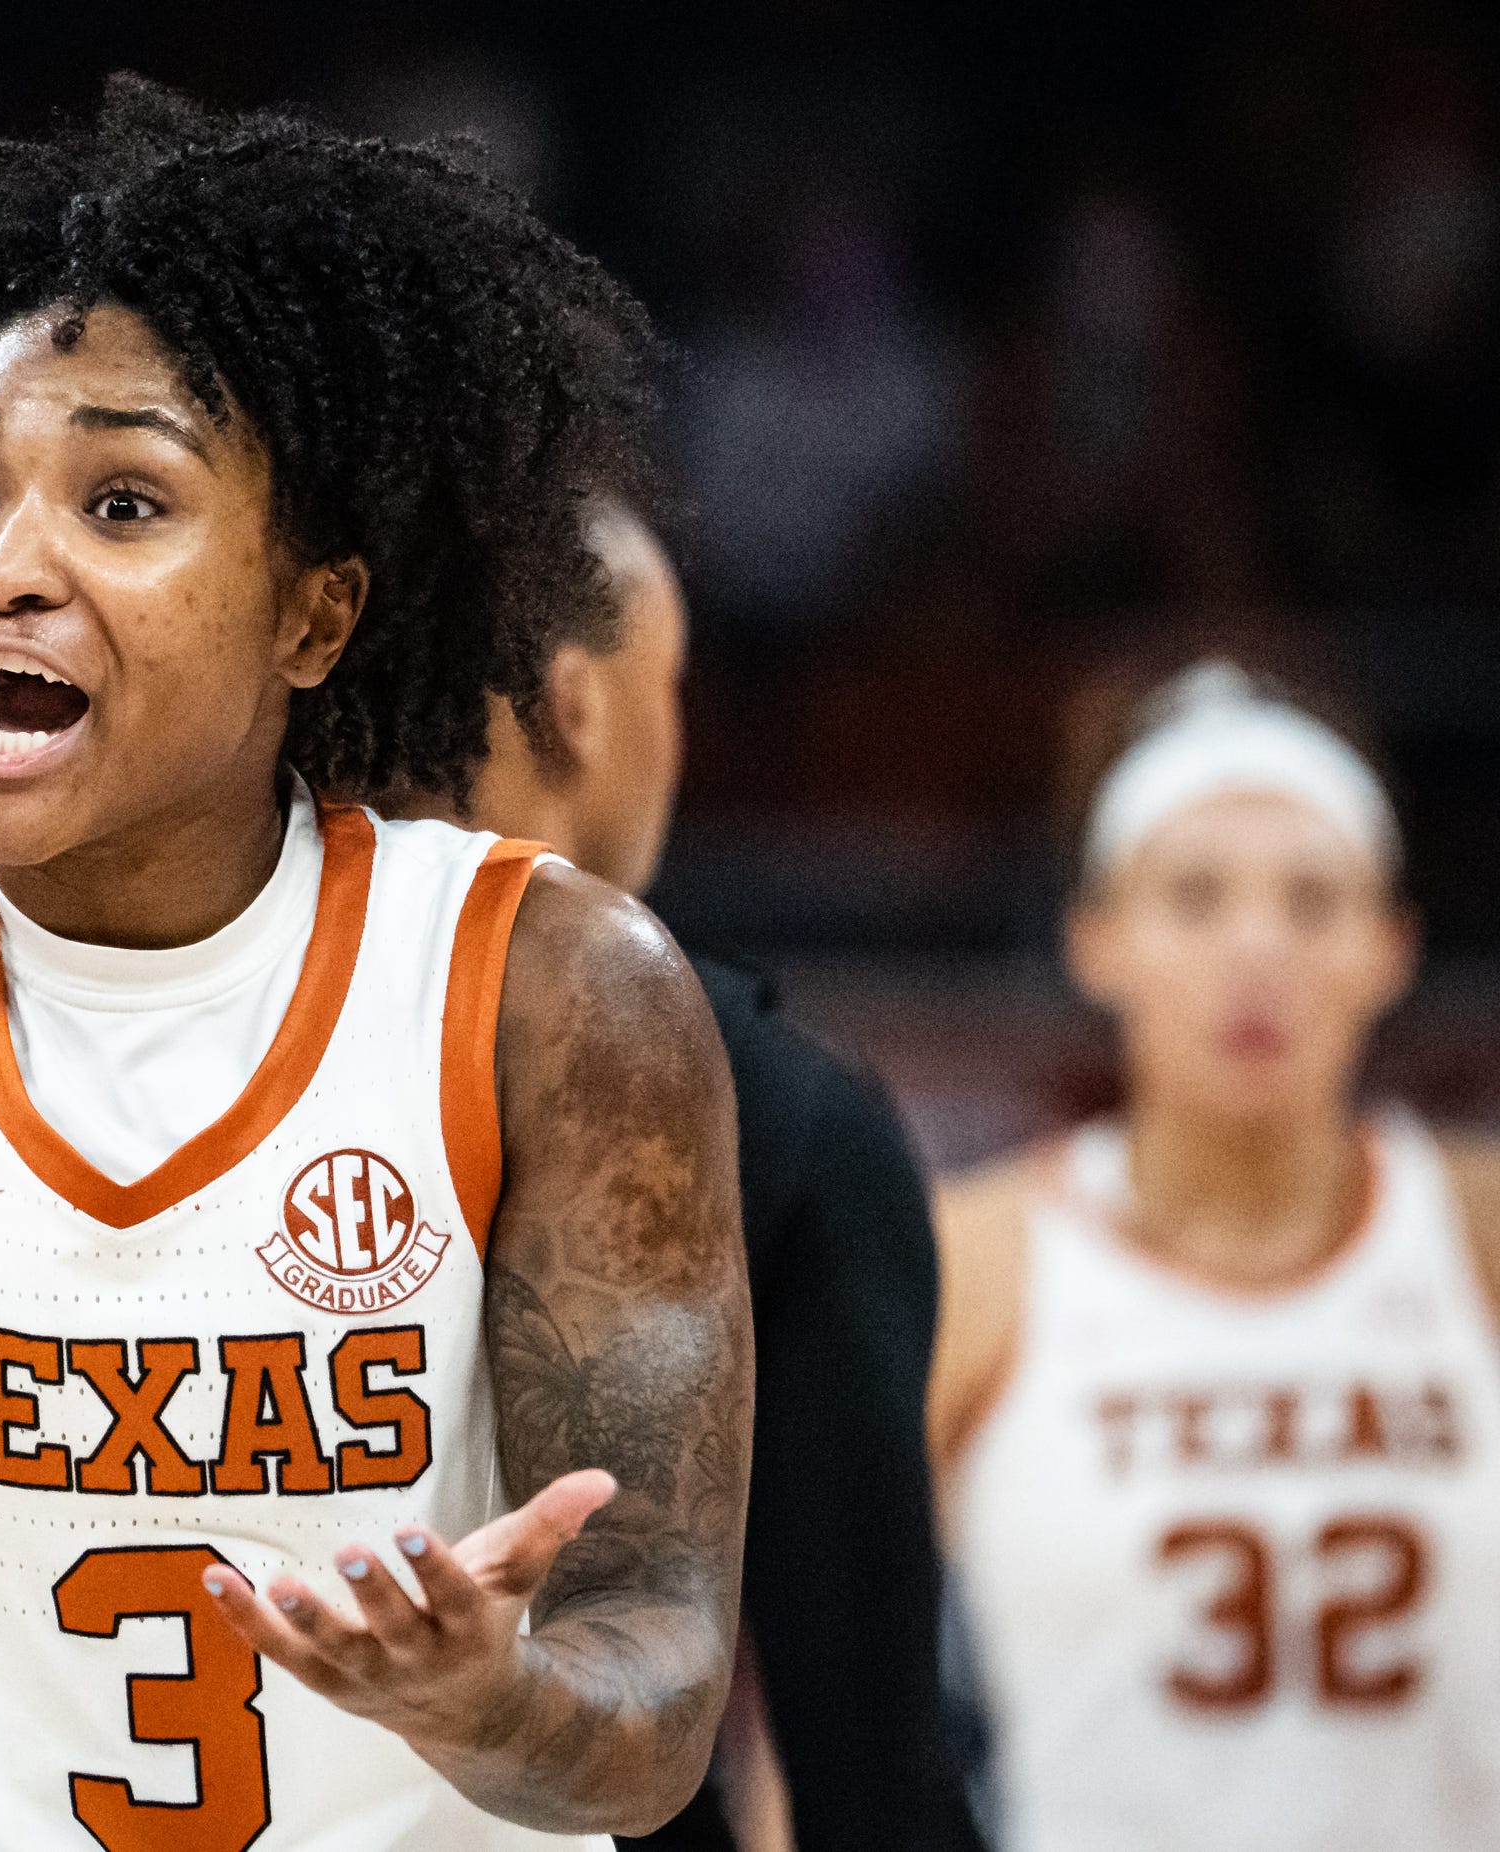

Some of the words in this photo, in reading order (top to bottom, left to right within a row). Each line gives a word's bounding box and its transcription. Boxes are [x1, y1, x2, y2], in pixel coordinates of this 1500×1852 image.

[283, 1258, 427, 1310] GRADUATE
[291, 1154, 407, 1270] SEC
[1153, 1510, 1430, 1718] 32
[51, 1543, 271, 1852] 3
